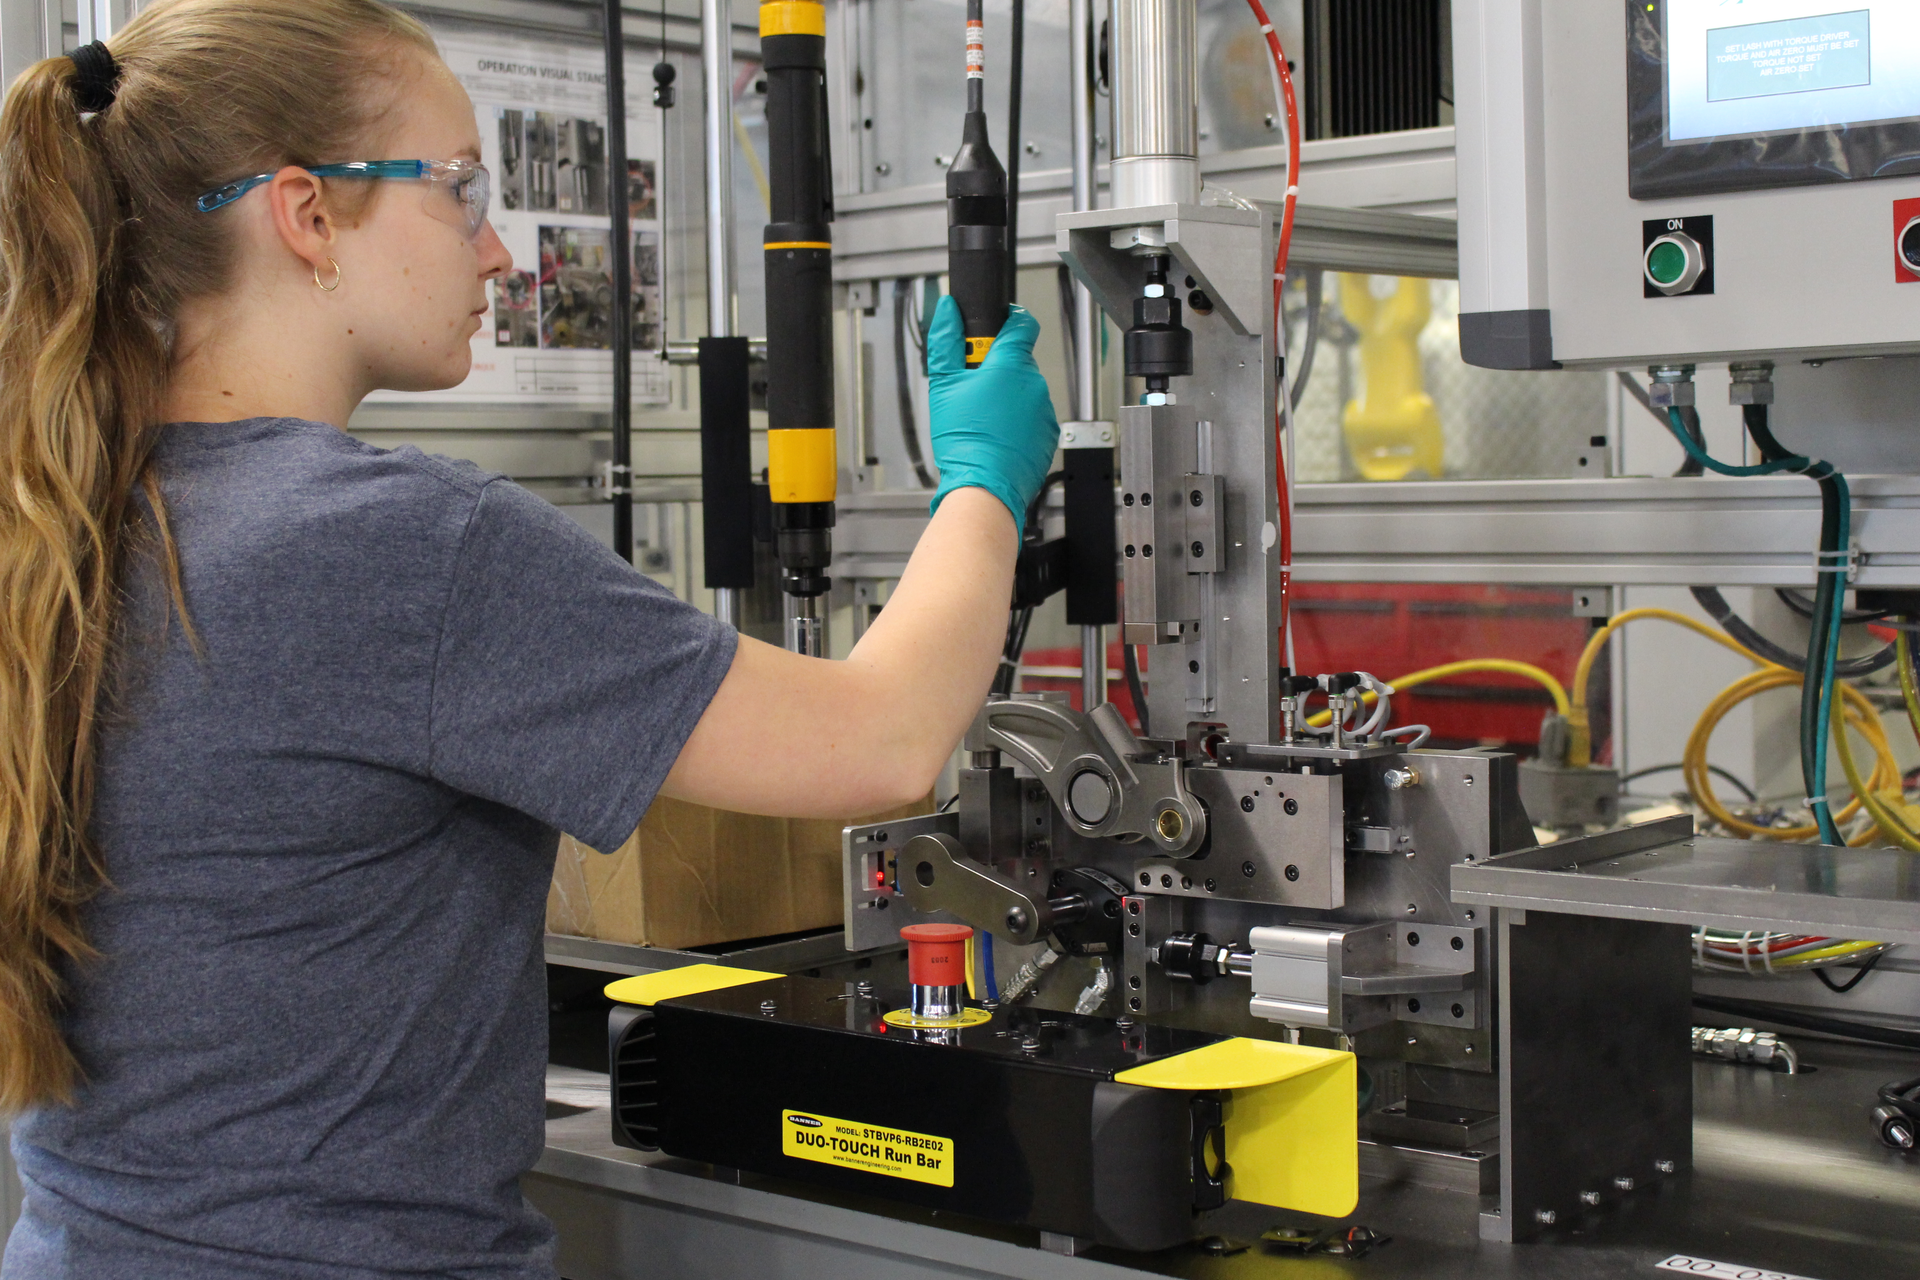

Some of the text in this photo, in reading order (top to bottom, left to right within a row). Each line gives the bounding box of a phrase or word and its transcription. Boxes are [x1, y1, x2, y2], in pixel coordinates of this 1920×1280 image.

[1716, 39, 1860, 63] TORQUE AND AIR ZERO MUST BE SET
[1725, 31, 1850, 53] SET LASH WITH TORQUE DRIVER
[1752, 53, 1822, 69] TORQUE NOT SET
[1760, 63, 1815, 77] AIR ZERO SET
[478, 59, 607, 86] OPERATION VISUAL STAND
[1667, 219, 1684, 231] ON
[789, 1116, 822, 1127] BANNER
[836, 1126, 944, 1152] MODEL: STBVP6-RB2E02
[796, 1131, 942, 1170] DUO-TOUCH Run Bar
[833, 1155, 902, 1172] www.bannerengineering.com
